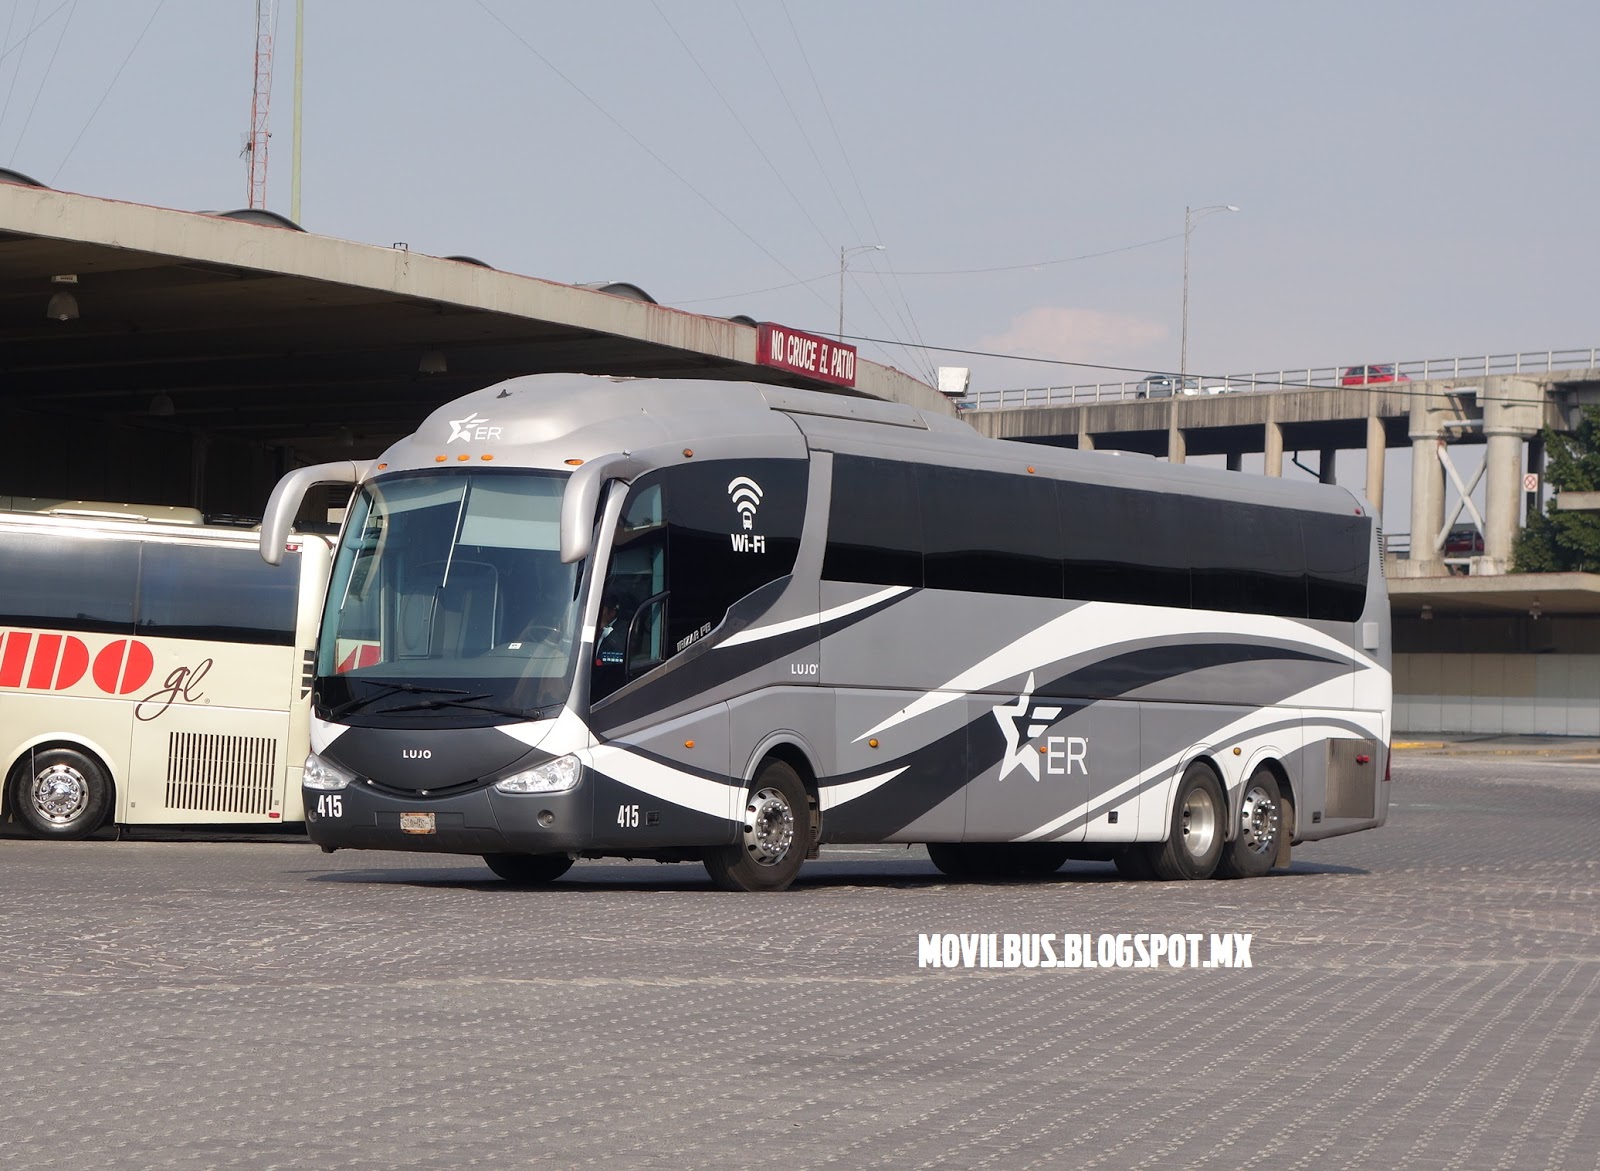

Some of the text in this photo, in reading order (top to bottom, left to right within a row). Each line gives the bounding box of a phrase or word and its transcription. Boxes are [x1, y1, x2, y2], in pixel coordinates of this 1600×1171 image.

[771, 329, 855, 381] NO CRUCE EL PATIO
[474, 426, 503, 440] ER
[730, 533, 766, 554] Wi-Fi
[791, 663, 817, 675] LUJO
[135, 658, 214, 721] gl
[402, 749, 432, 759] LUJO
[1046, 736, 1088, 776] ER
[317, 794, 343, 818] 415
[616, 804, 640, 828] 415
